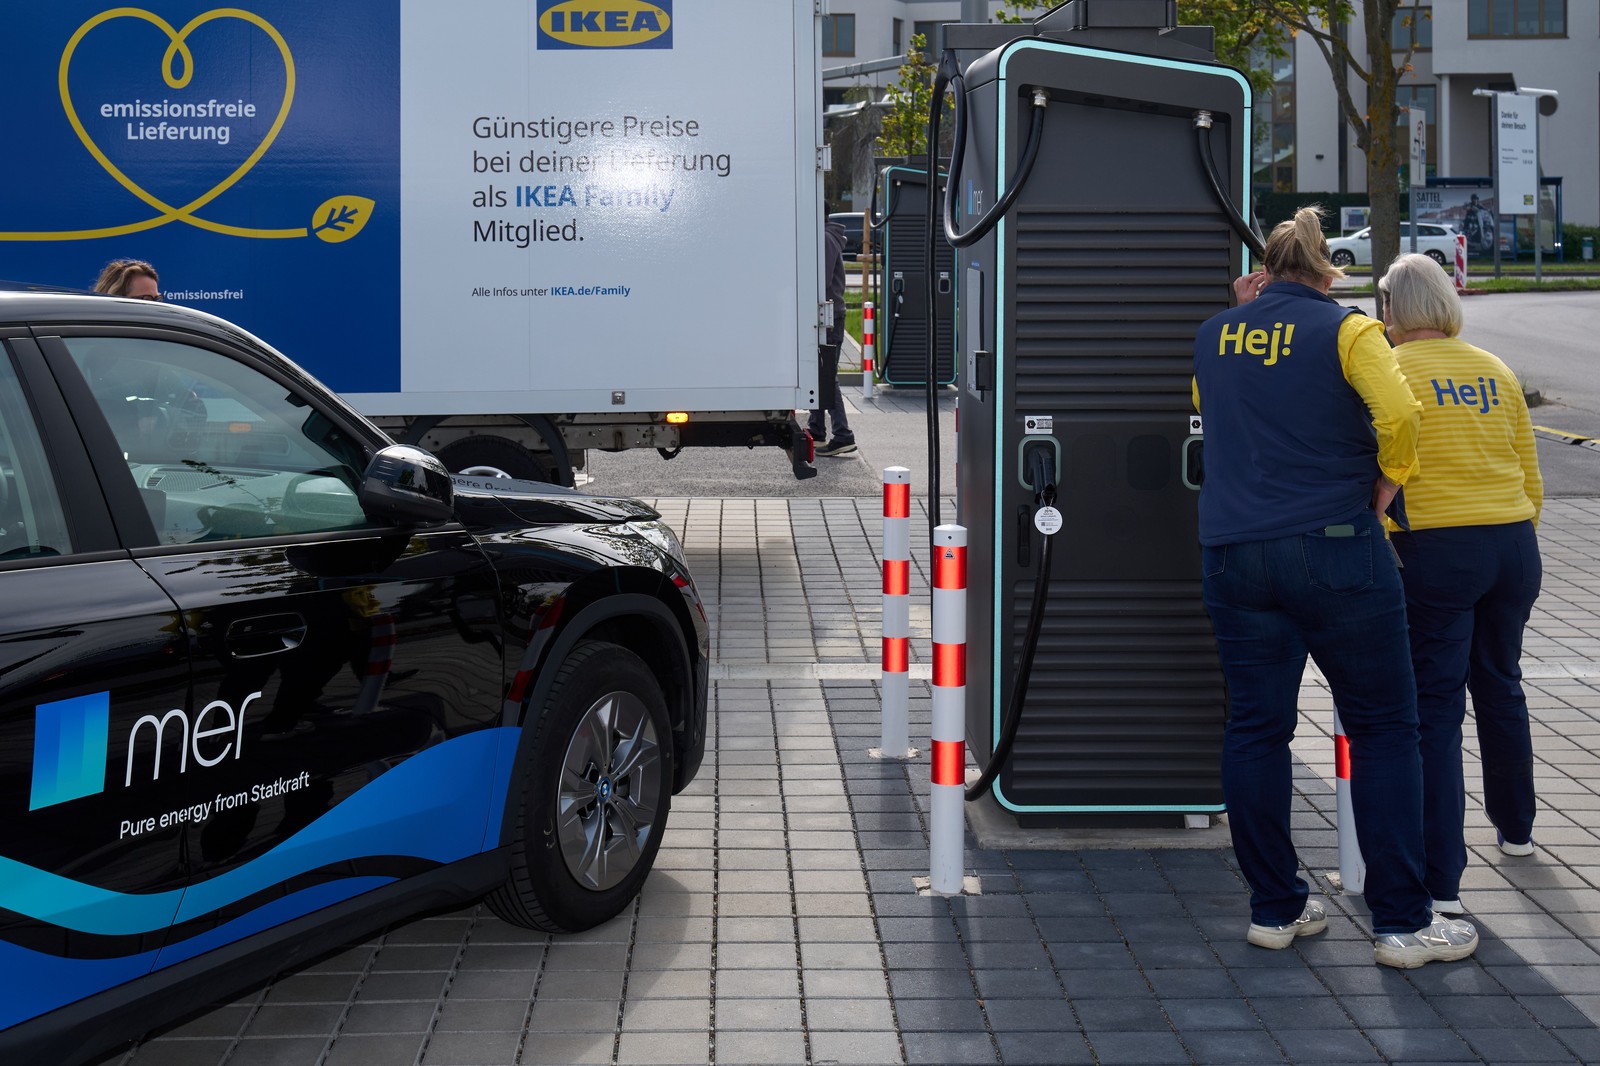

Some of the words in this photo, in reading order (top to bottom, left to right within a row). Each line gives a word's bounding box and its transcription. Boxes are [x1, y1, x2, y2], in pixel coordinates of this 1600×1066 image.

[550, 10, 663, 33] IKEA
[100, 99, 256, 118] emissionsfreie
[126, 122, 230, 144] Lieferung
[472, 115, 614, 145] Günstigere
[623, 115, 700, 138] Preise
[473, 150, 510, 173] bei
[519, 150, 600, 173] deiner
[472, 184, 508, 208] als
[516, 184, 577, 207] IKEA
[585, 184, 675, 212] Family
[473, 218, 584, 249] Mitglied.
[163, 289, 244, 300] /emissionsfrei
[471, 287, 491, 297] Alle
[493, 287, 518, 297] Infos
[520, 287, 548, 297] unter
[550, 285, 631, 298] IKEA.de/Family
[1219, 322, 1295, 366] Hej!
[1431, 376, 1499, 414] Hej!
[125, 691, 262, 787] mer
[119, 816, 156, 840] Pure
[159, 800, 212, 829] energy
[214, 792, 248, 813] from
[250, 771, 310, 802] Statkraft
